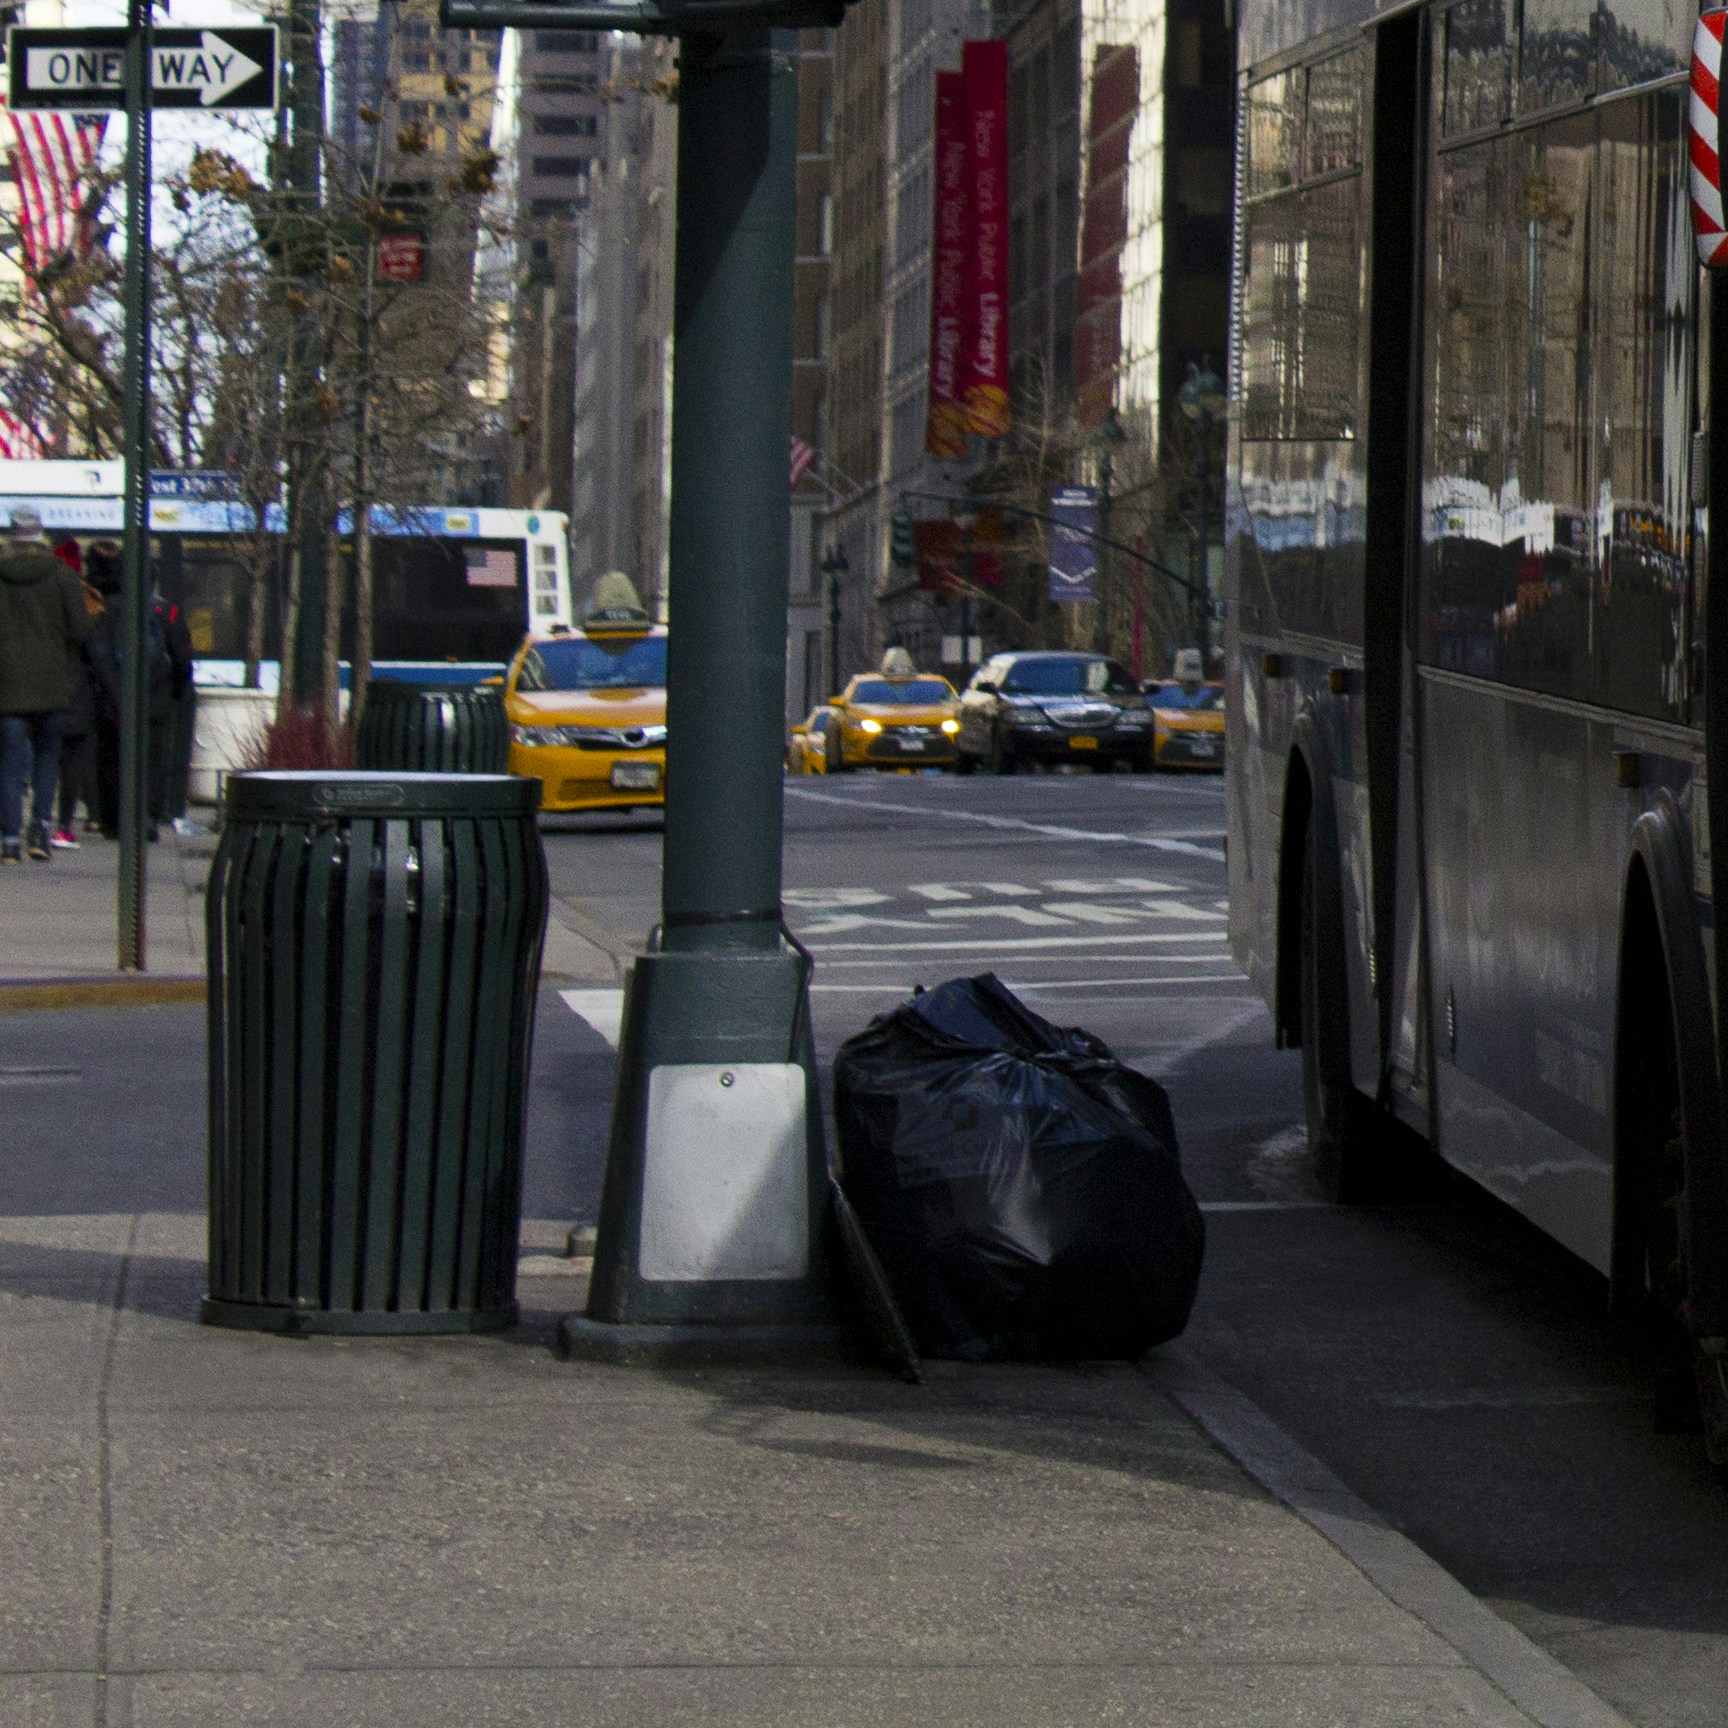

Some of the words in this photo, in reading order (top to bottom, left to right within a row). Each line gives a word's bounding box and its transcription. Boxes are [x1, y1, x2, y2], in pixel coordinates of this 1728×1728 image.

[49, 53, 122, 84] ONE
[159, 53, 235, 84] WAY
[975, 293, 998, 378] Library
[152, 477, 178, 494] est
[798, 901, 1228, 934] NLY
